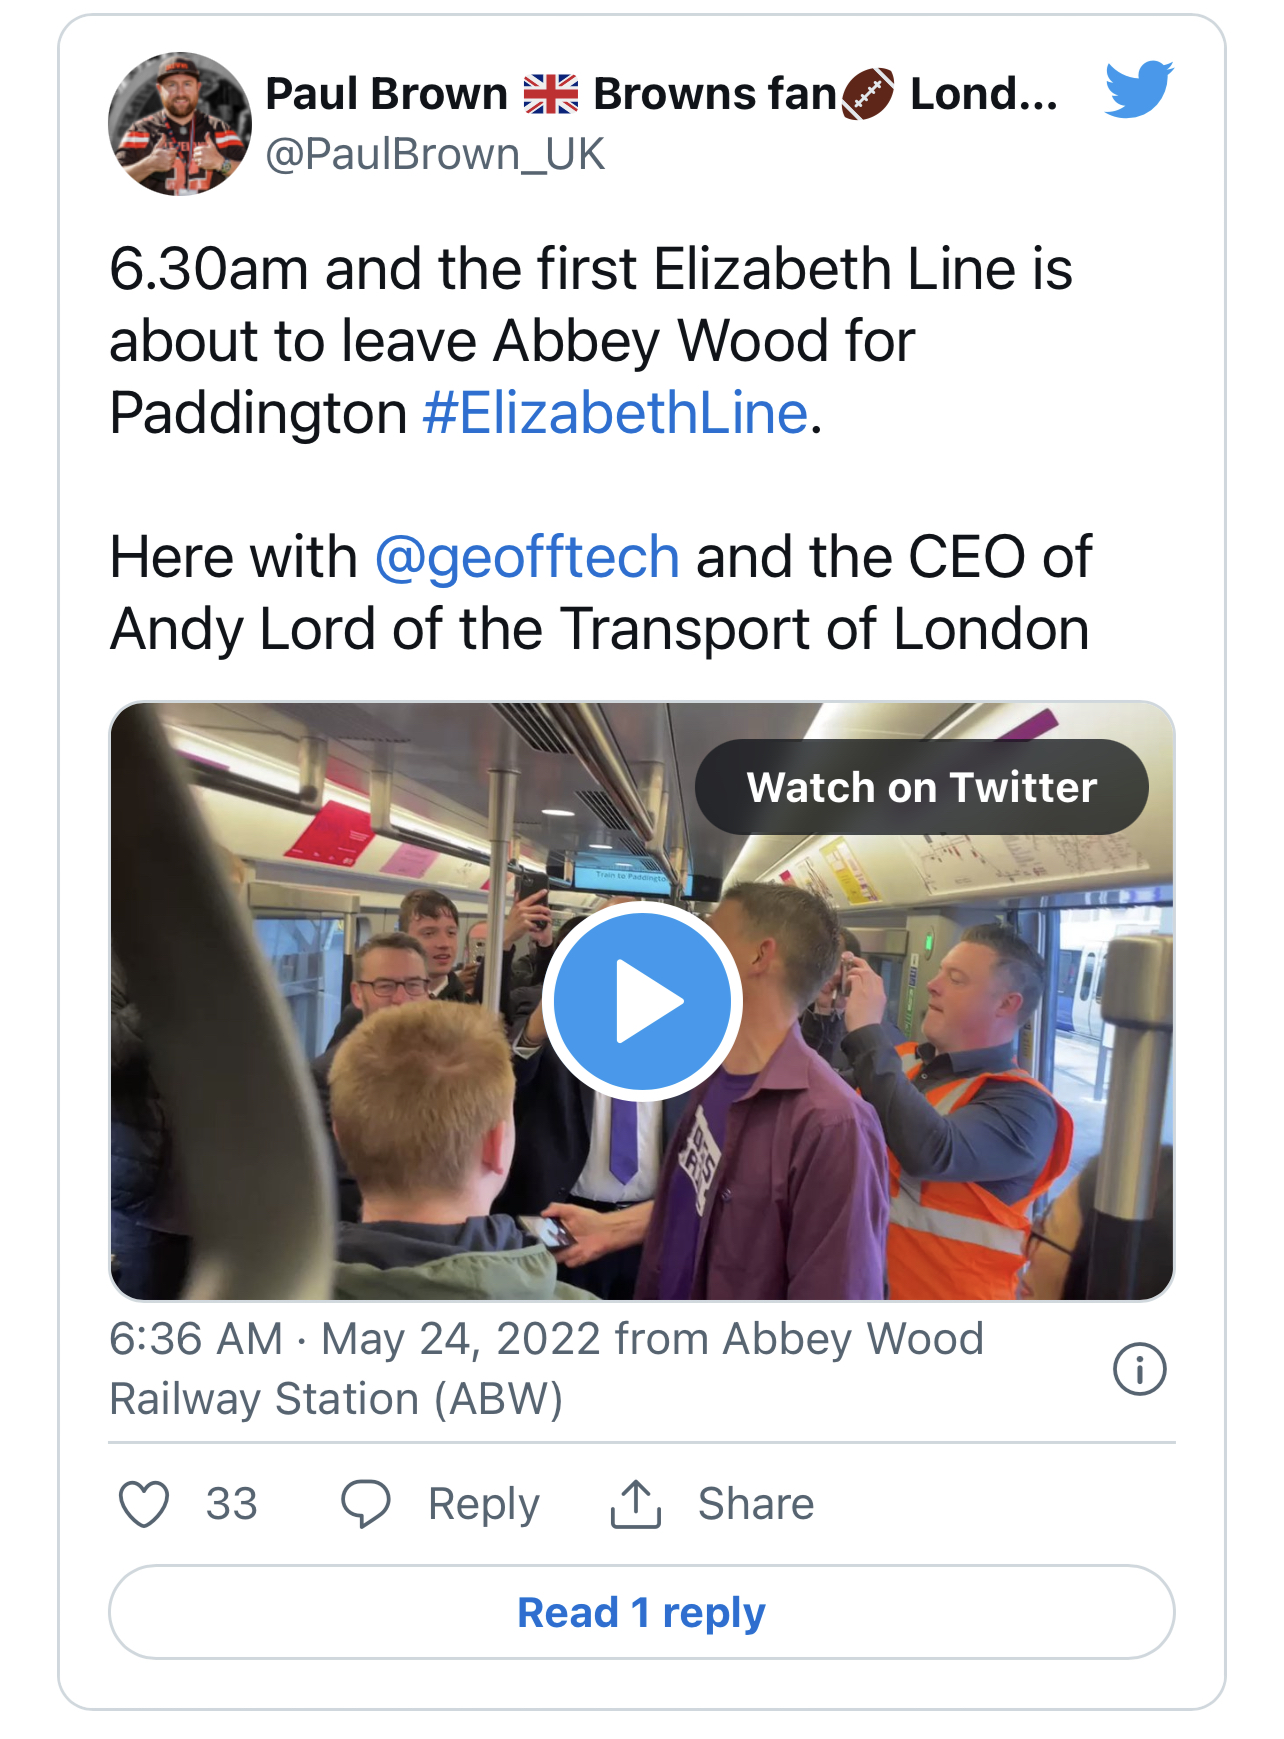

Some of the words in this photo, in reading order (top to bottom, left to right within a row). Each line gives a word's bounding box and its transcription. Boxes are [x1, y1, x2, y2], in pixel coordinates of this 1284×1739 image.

[596, 870, 616, 879] Train
[617, 872, 626, 880] to
[628, 872, 668, 883] Paddingto
